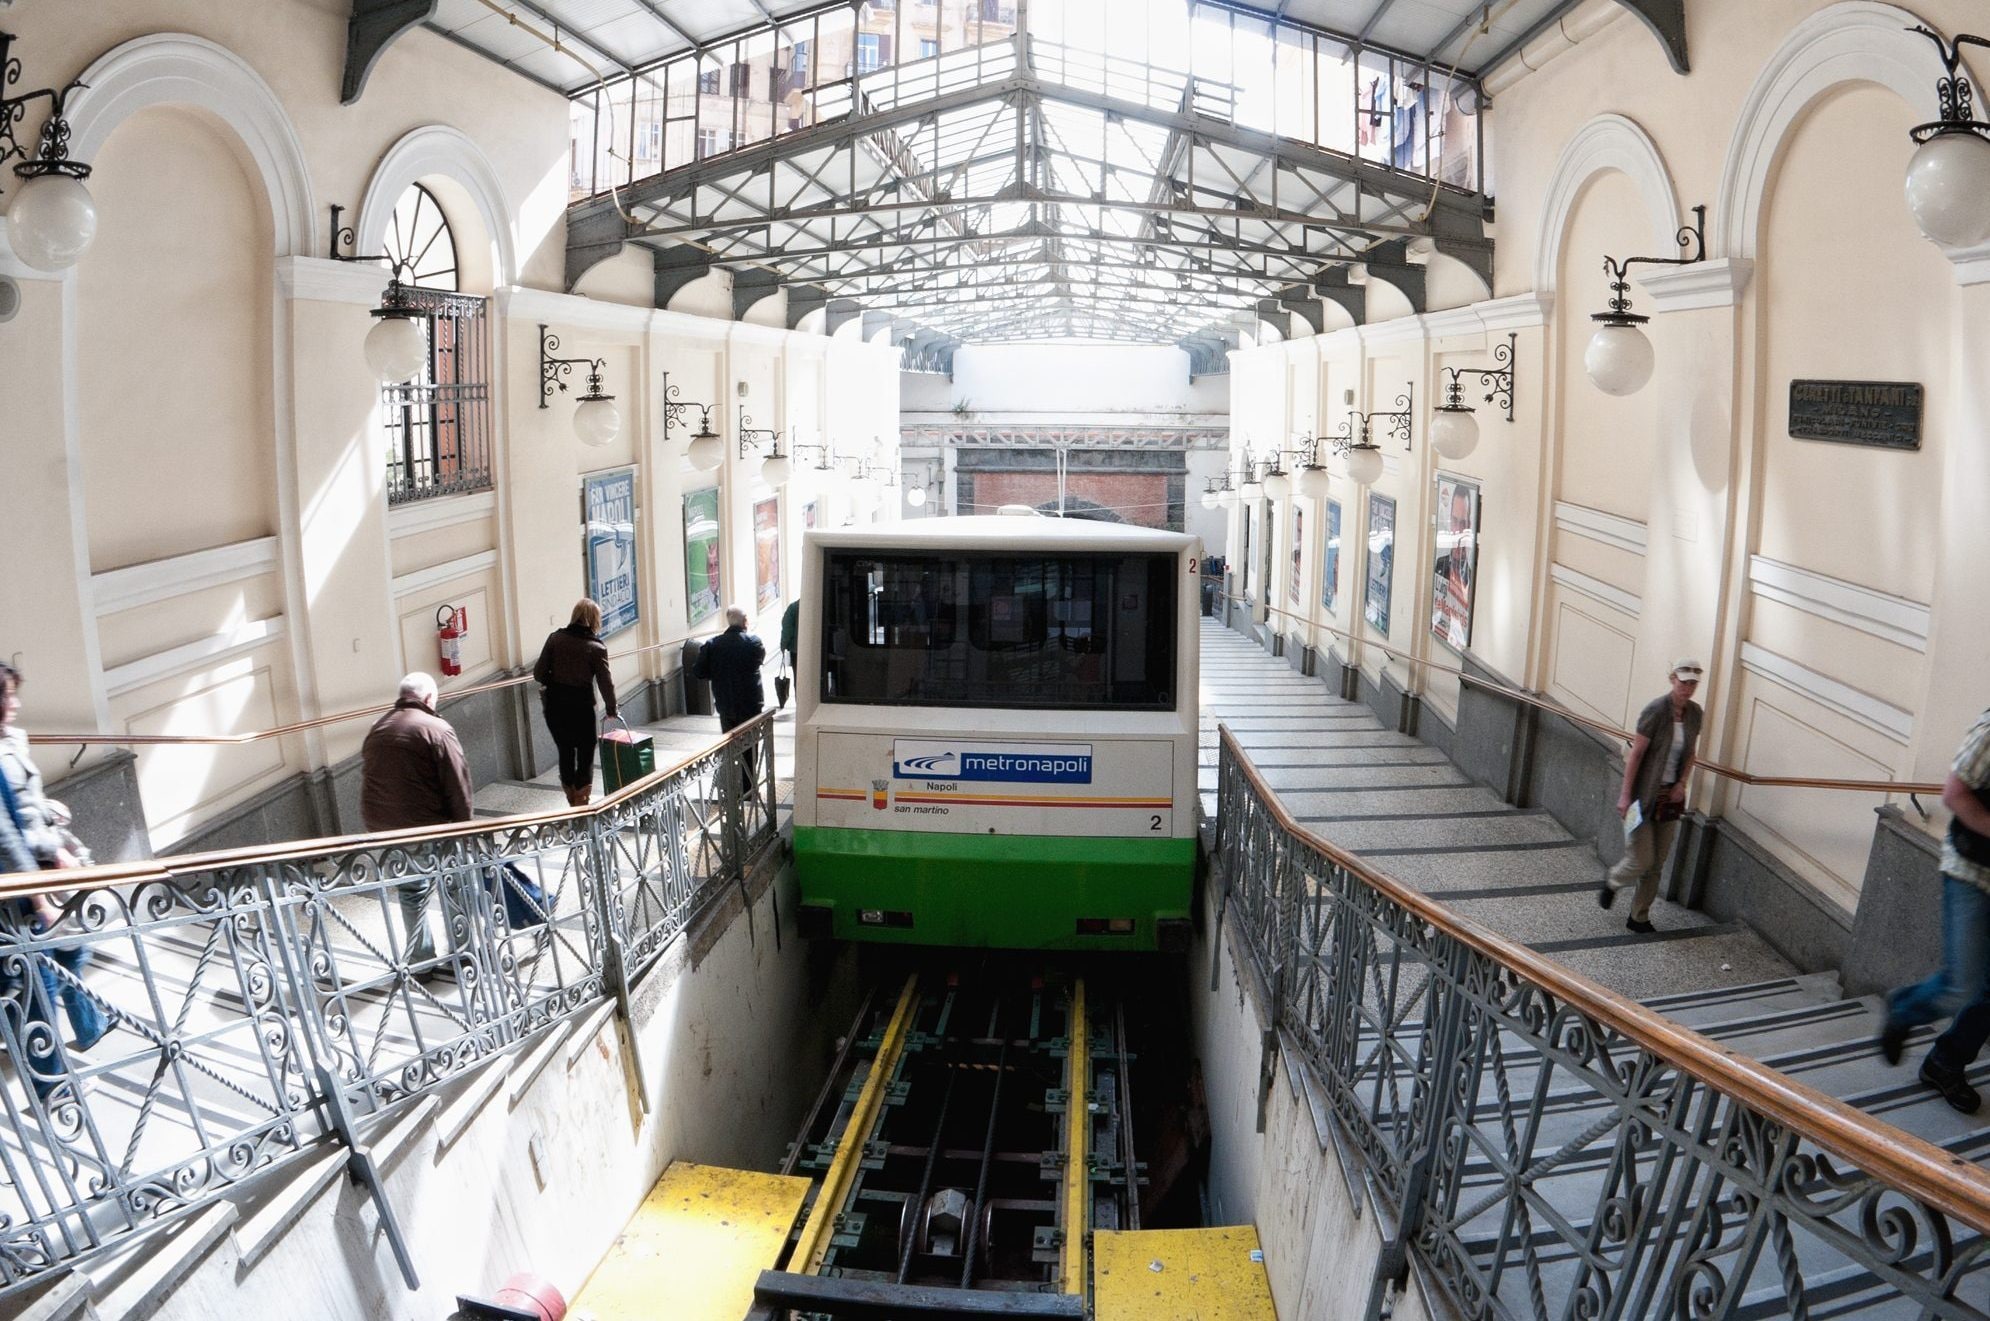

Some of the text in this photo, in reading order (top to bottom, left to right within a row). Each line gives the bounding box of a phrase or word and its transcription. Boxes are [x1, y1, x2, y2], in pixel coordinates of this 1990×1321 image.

[1189, 558, 1197, 574] 2
[600, 572, 630, 598] LETTIERI
[600, 587, 630, 614] SINDACO
[965, 756, 1088, 775] metronapoli
[926, 782, 958, 792] Napoli
[894, 804, 950, 816] san martino
[1150, 815, 1162, 830] 2
